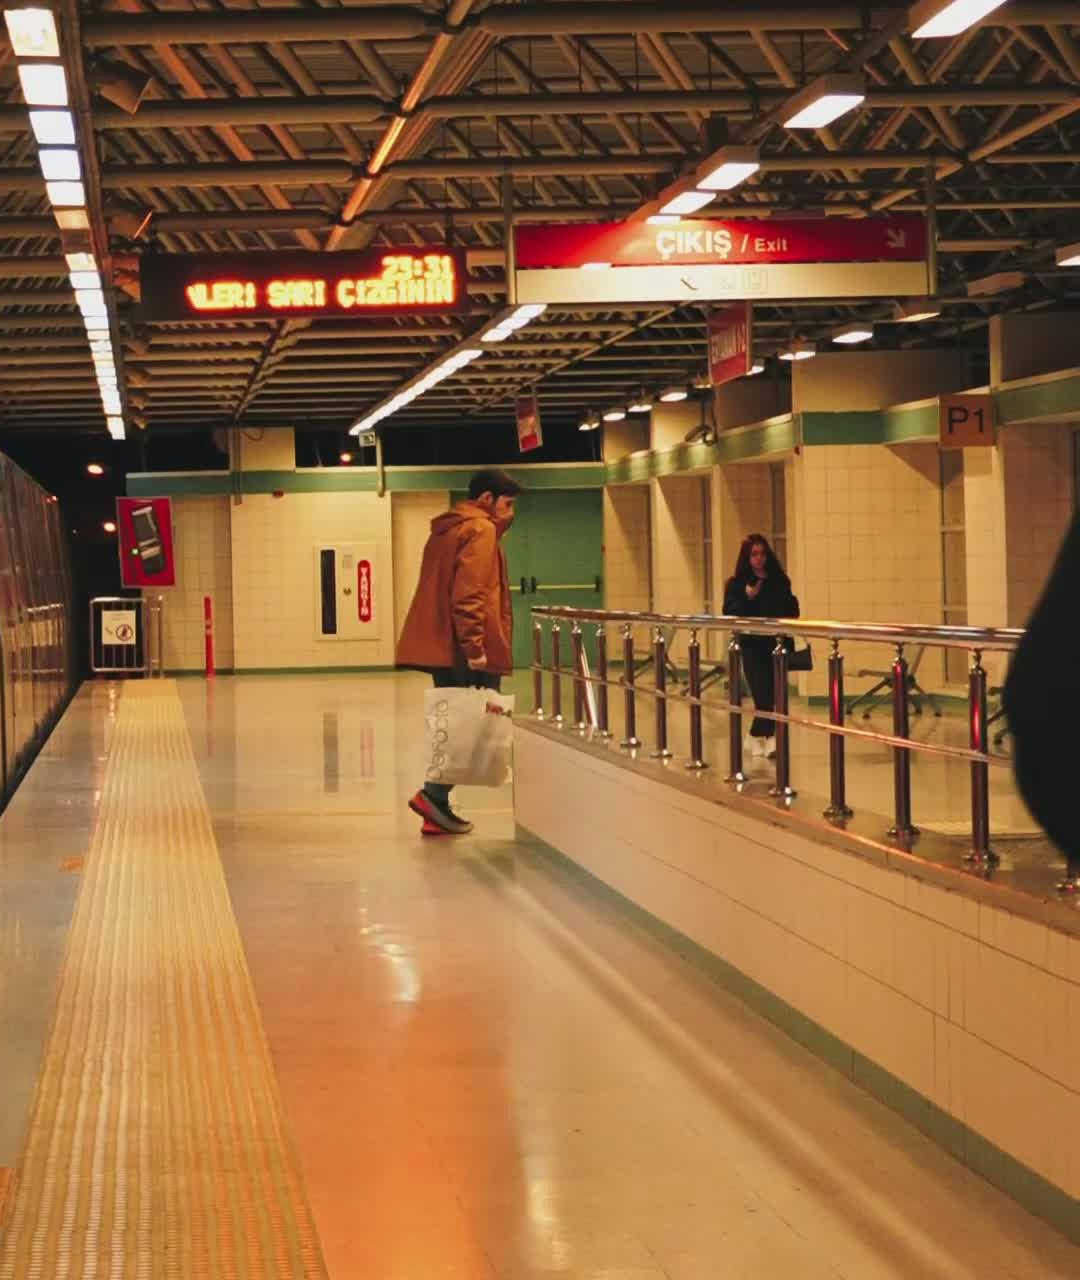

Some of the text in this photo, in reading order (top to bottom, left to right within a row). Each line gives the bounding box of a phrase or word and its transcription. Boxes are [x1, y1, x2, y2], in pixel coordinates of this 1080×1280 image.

[655, 229, 732, 260] ÇIKIŞ
[754, 237, 788, 252] Exit
[948, 407, 984, 433] P1
